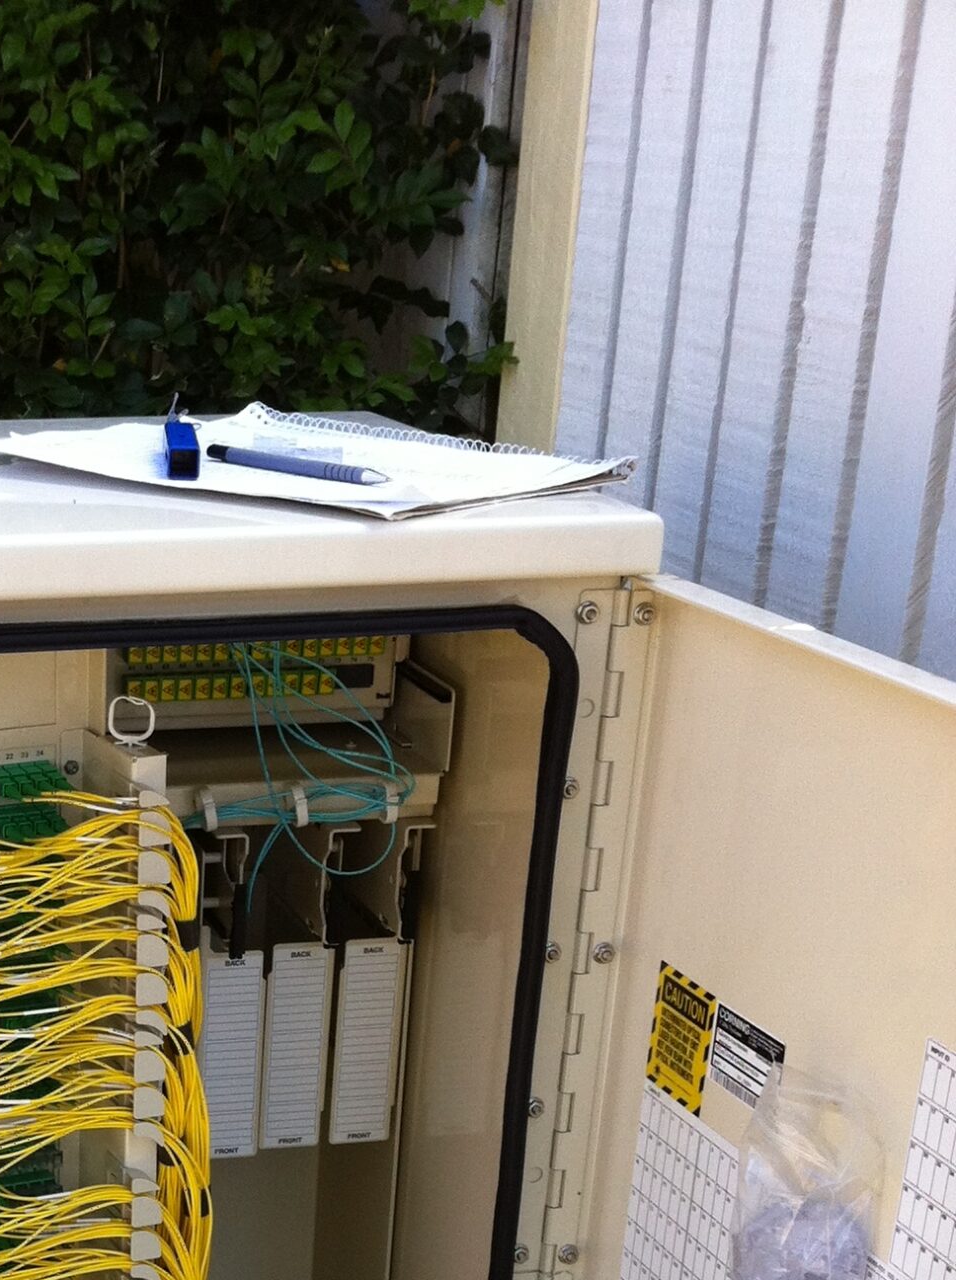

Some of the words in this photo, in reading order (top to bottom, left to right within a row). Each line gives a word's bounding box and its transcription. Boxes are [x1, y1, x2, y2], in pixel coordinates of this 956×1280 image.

[363, 946, 385, 954] BACK
[290, 951, 312, 959] BACK
[664, 981, 707, 1026] CAUTION
[347, 1132, 372, 1140] FRONT
[278, 1137, 302, 1145] FRONT
[214, 1147, 239, 1155] FRONT
